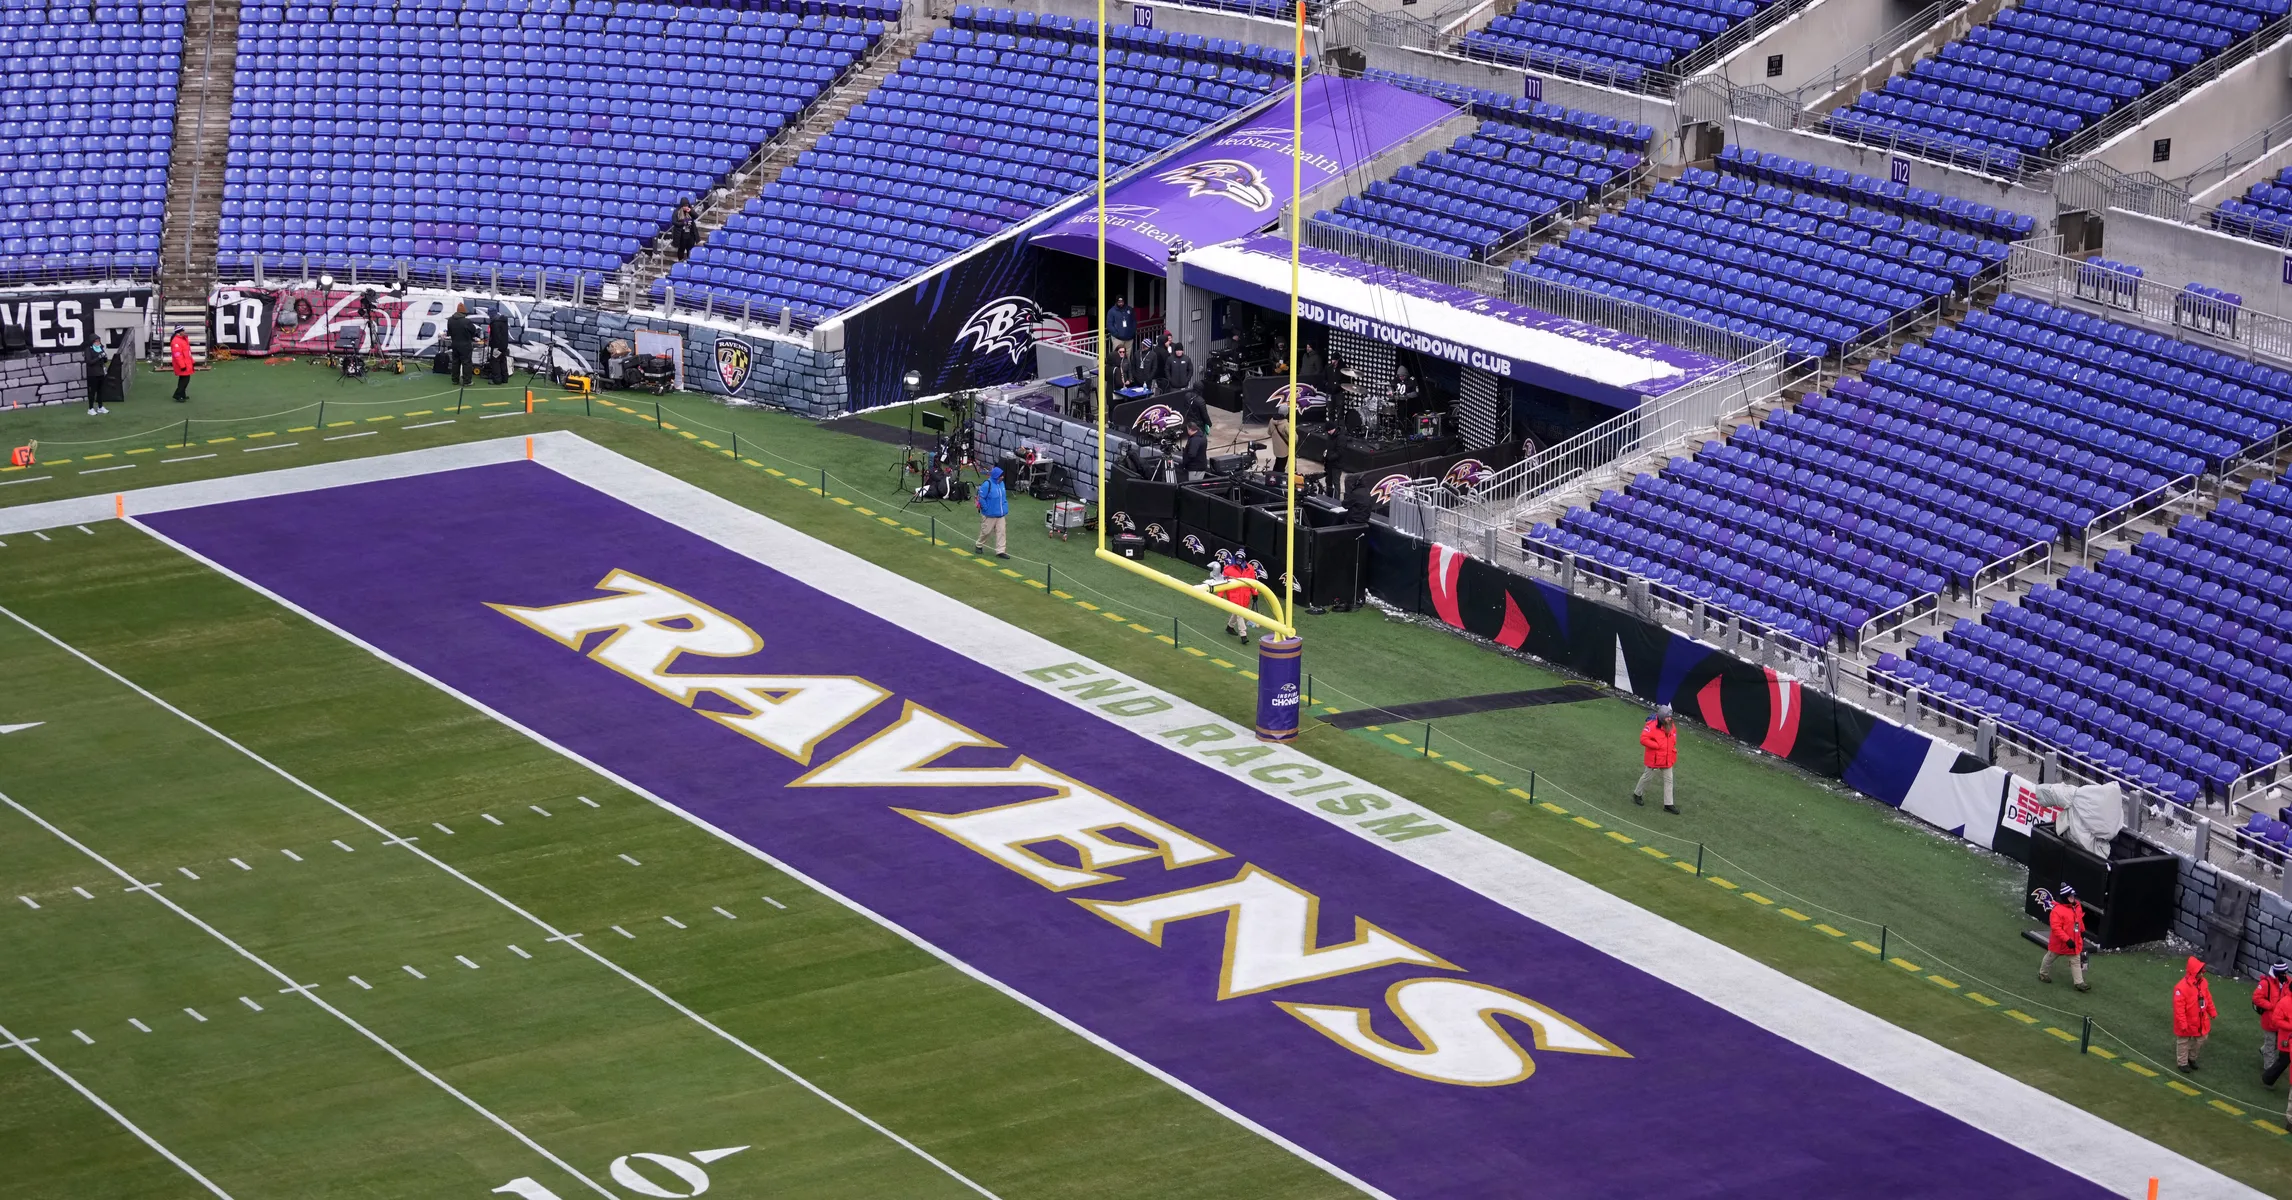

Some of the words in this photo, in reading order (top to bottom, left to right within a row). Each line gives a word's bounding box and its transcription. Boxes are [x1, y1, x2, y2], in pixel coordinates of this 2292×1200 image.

[1135, 8, 1151, 26] 109
[1528, 79, 1540, 98] 111
[1212, 137, 1280, 149] MedStar
[1893, 161, 1908, 182] 112
[1132, 221, 1195, 253] Healh
[719, 341, 748, 352] RAVENS
[1297, 301, 1324, 322] BUD
[1327, 312, 1368, 339] LIGHT
[1371, 322, 1468, 364] TOUCHDOWN
[1471, 351, 1511, 376] CLUB
[1272, 695, 1299, 706] CHANG
[1023, 661, 1173, 717] END
[1159, 722, 1451, 842] RACISM
[482, 568, 1634, 1086] RAVENS
